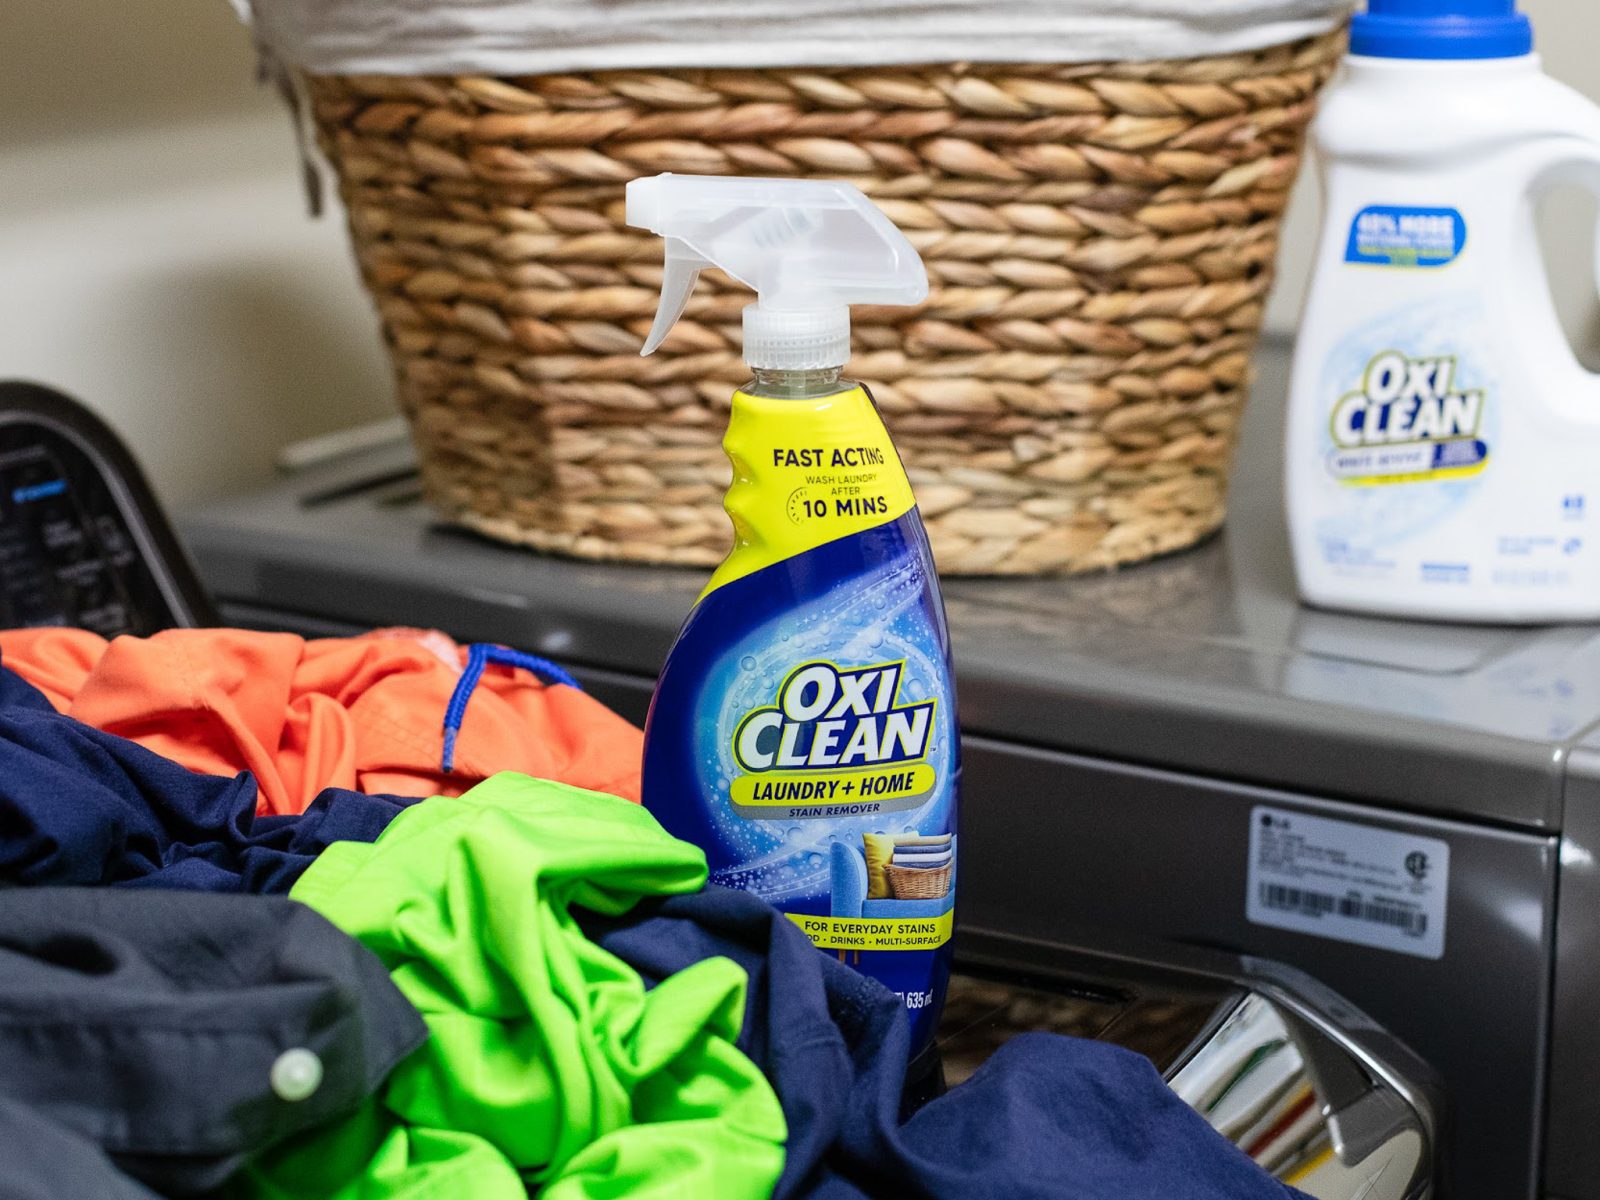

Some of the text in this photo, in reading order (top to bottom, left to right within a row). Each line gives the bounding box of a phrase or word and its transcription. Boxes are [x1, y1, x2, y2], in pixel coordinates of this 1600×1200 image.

[1366, 355, 1452, 404] OXI
[1333, 391, 1481, 447] CLEAN
[773, 447, 884, 467] FAST ACTING
[806, 473, 877, 485] WASH LAUNDRY
[831, 487, 860, 496] AFTER
[803, 496, 888, 518] 10 MINS
[783, 666, 898, 722] OXI
[738, 706, 931, 769] CLEAN
[752, 780, 840, 801] LAUNDRY
[860, 771, 915, 797] HOME
[789, 803, 880, 818] STAIN REMOVER
[804, 920, 936, 934] FOR EVERYDAY STAINS
[806, 934, 942, 946] OD DRINKS MULTI-SURFACE
[906, 991, 925, 1009] 635
